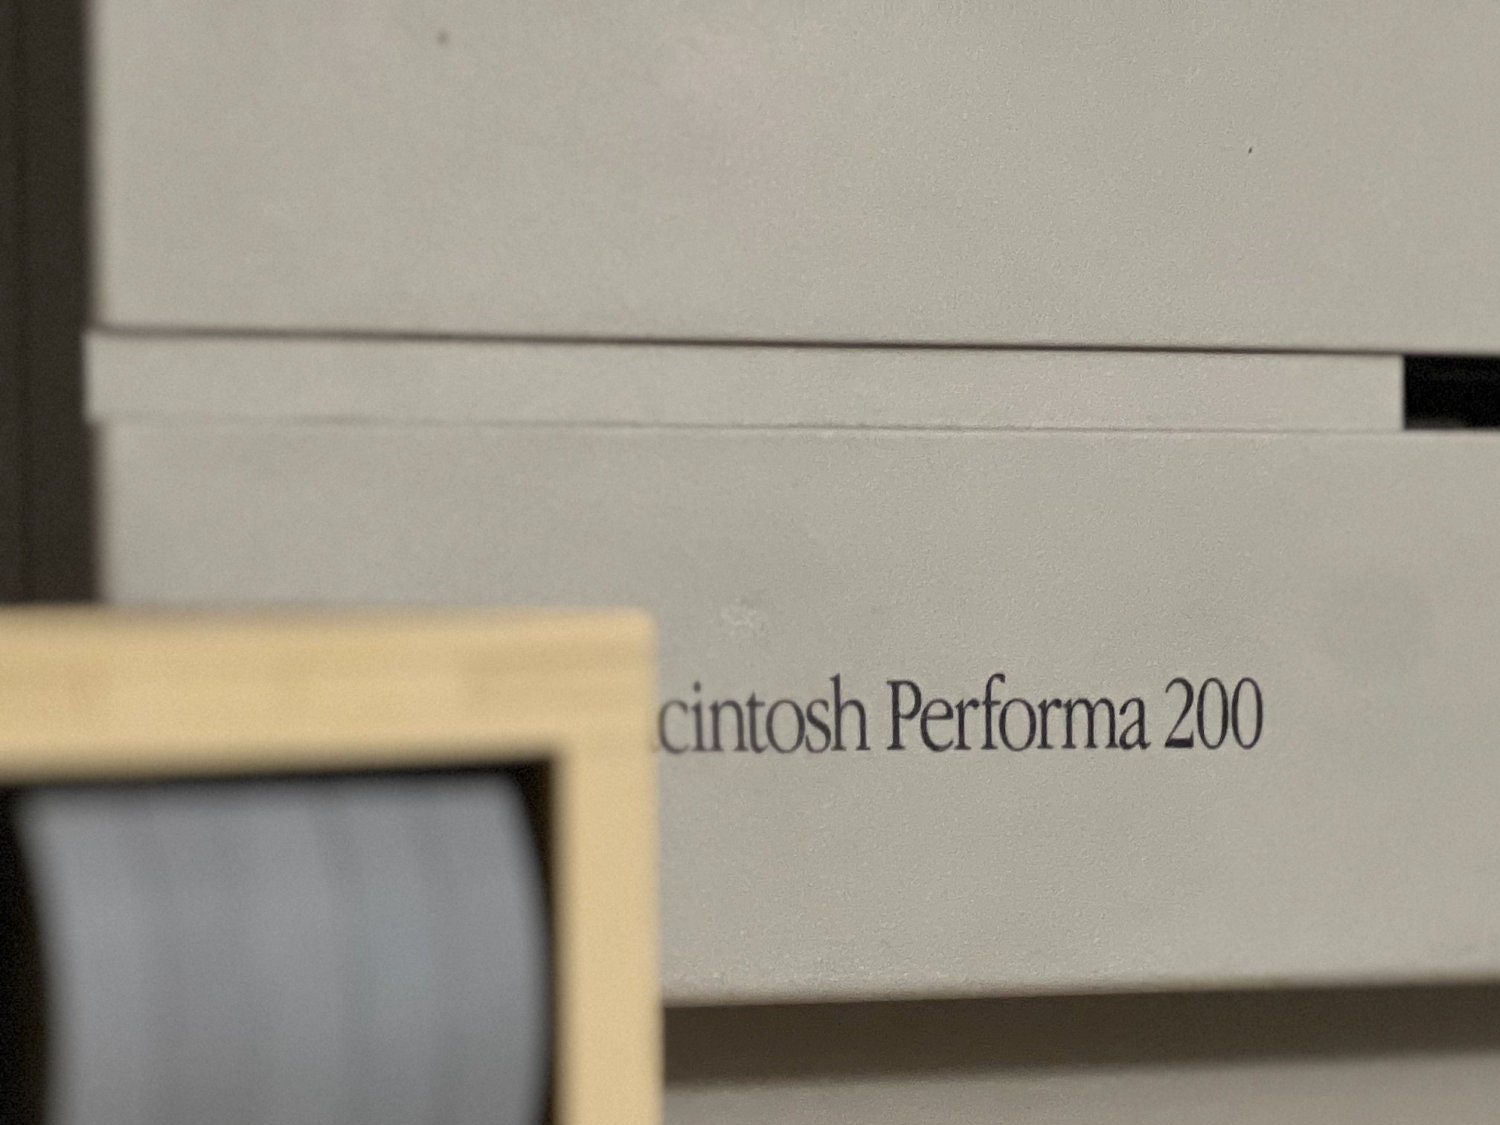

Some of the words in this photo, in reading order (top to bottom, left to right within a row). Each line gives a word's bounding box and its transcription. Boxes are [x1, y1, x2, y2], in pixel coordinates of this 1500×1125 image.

[655, 674, 871, 756] cintosh
[886, 673, 1152, 753] Performa
[1163, 676, 1264, 751] 200
